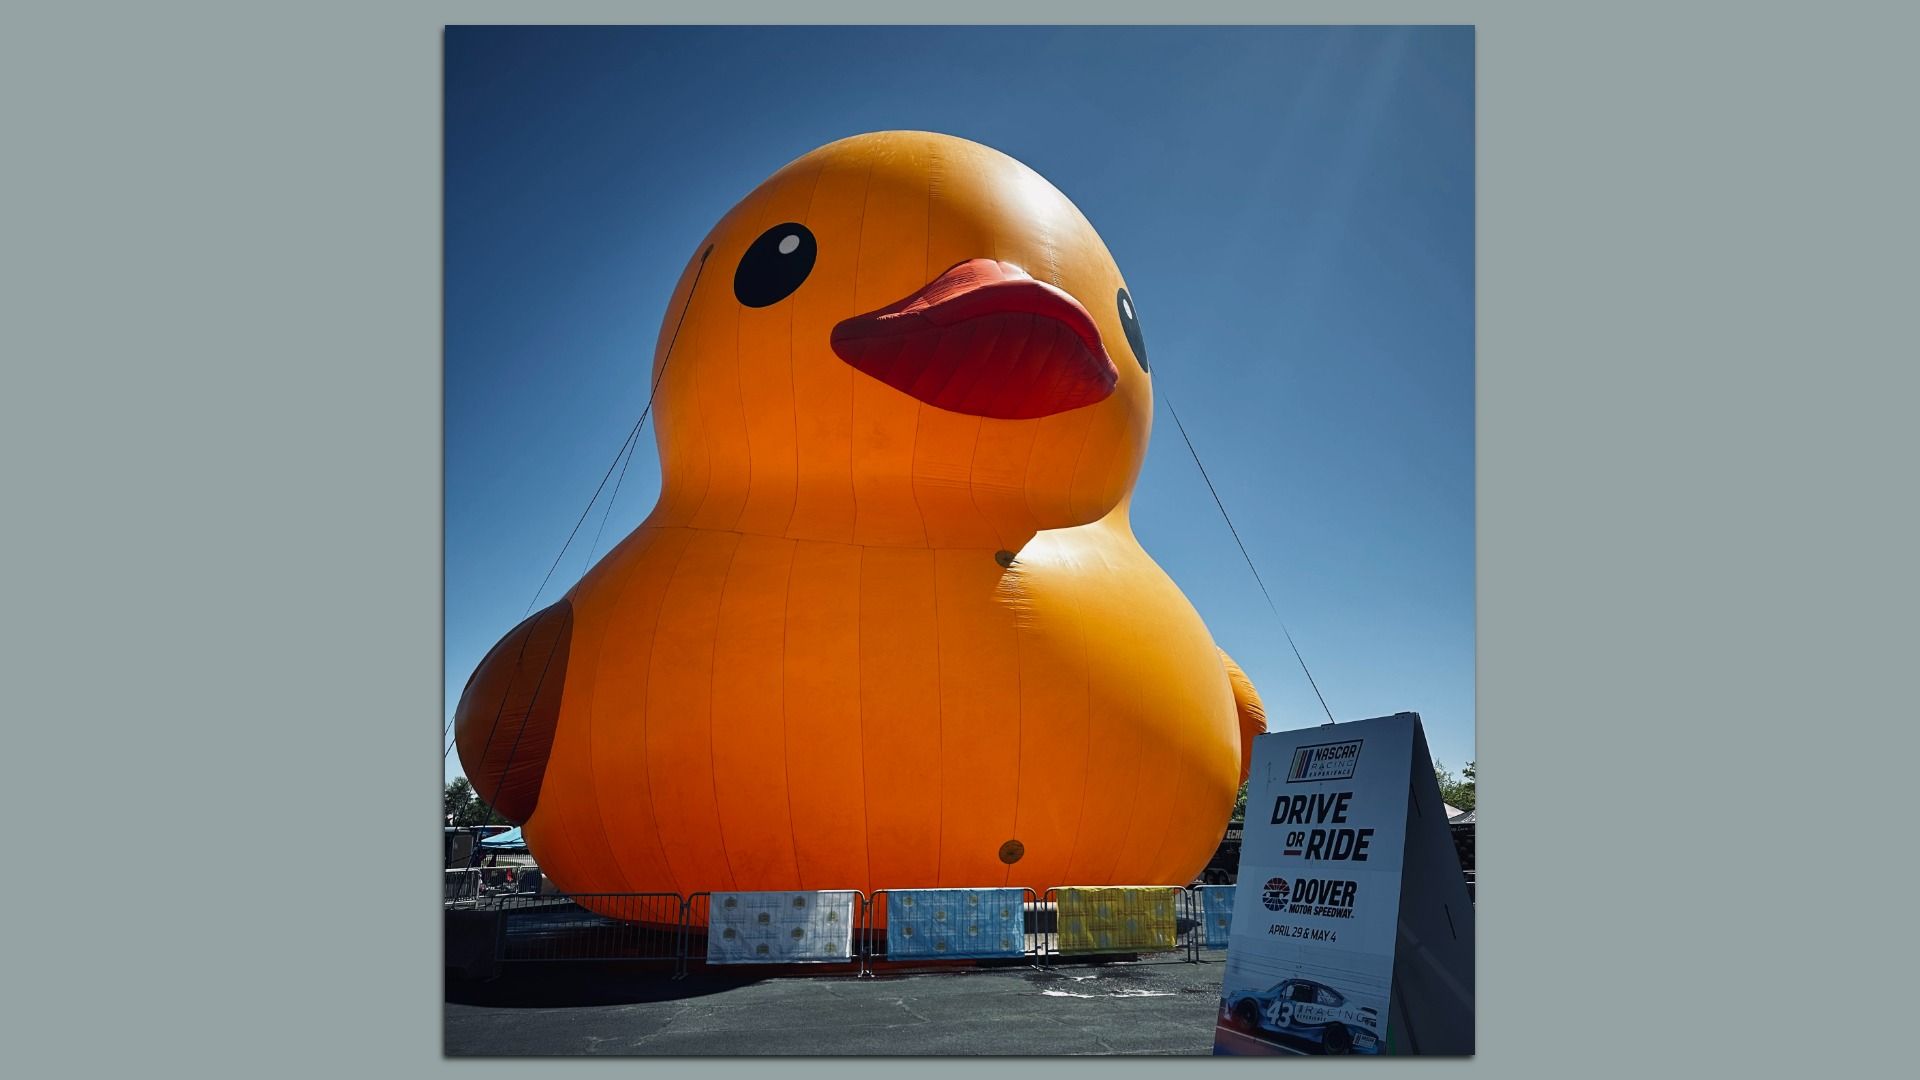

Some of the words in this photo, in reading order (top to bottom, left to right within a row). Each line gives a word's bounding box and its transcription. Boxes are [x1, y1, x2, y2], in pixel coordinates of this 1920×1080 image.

[1314, 745, 1357, 761] NASCAR
[1312, 760, 1354, 768] RACING
[1309, 769, 1350, 777] EXPERIENCE
[1271, 792, 1353, 824] DRIVE
[1286, 831, 1305, 847] OR
[1305, 829, 1374, 861] RIDE
[1291, 879, 1357, 907] DOVER
[1289, 904, 1312, 915] MOTOR
[1314, 906, 1352, 919] SPEEDWAY
[1268, 924, 1290, 937] APRIL
[1292, 927, 1303, 938] 29
[1303, 929, 1309, 939] &
[1311, 929, 1330, 941] MAY
[1330, 931, 1336, 942] 4
[1266, 1000, 1294, 1028] 43
[1305, 1005, 1363, 1022] RACING
